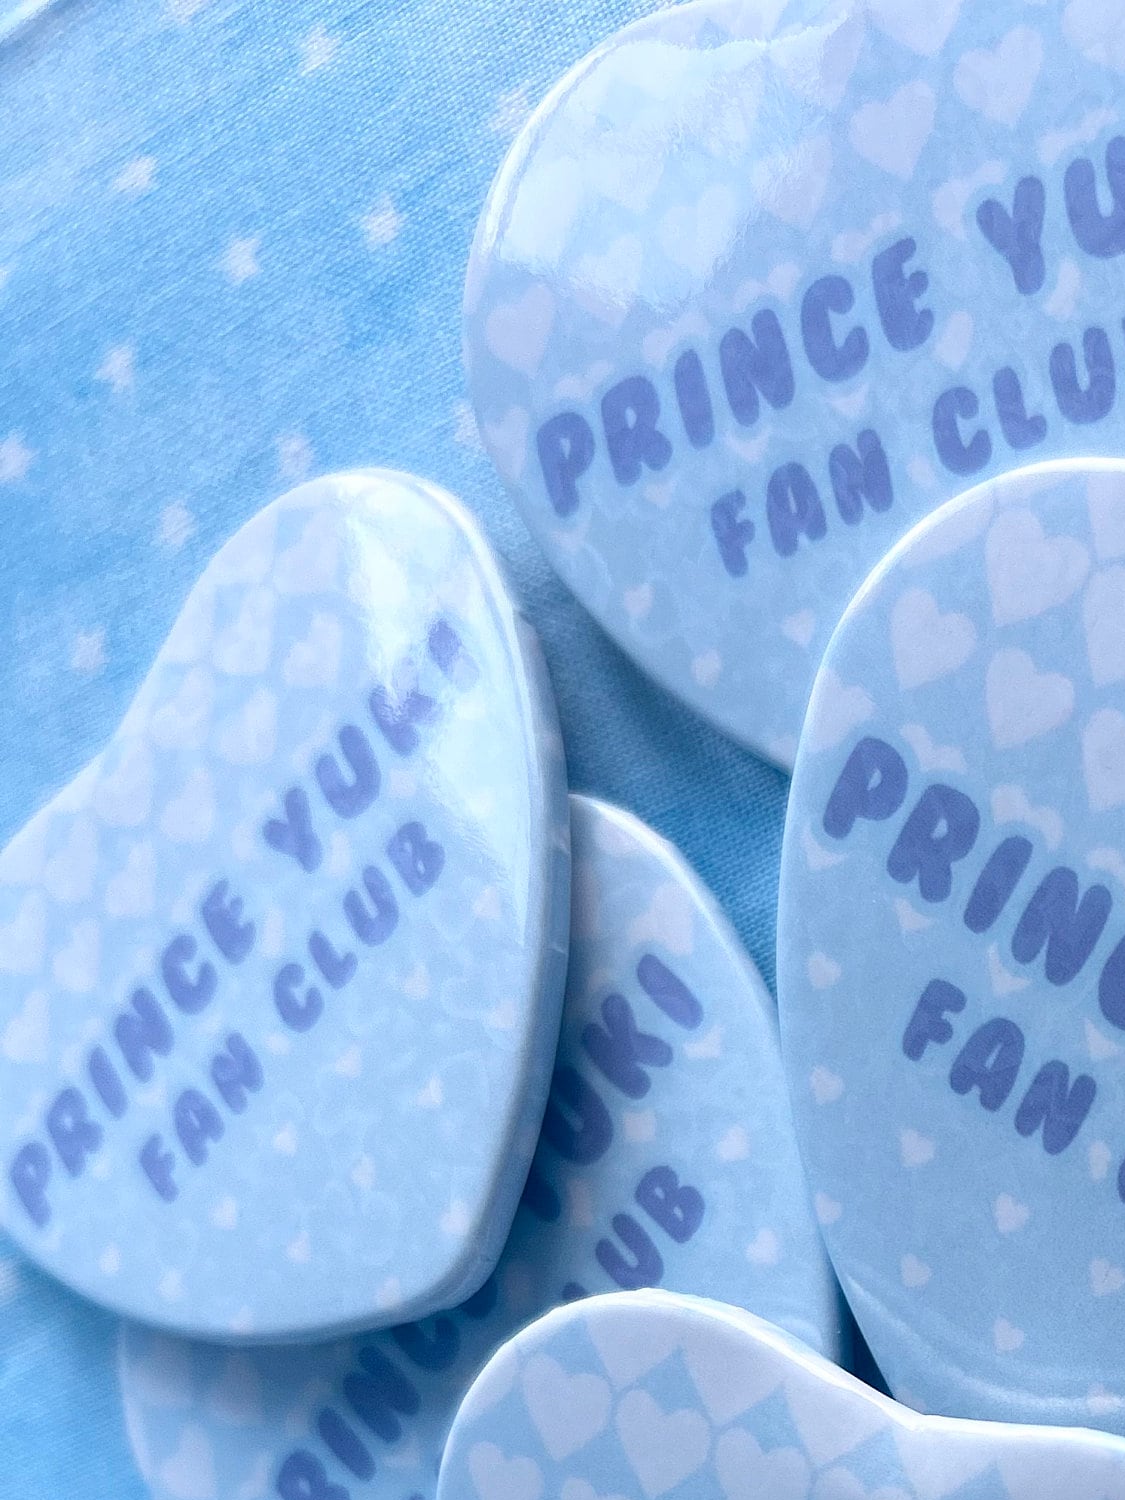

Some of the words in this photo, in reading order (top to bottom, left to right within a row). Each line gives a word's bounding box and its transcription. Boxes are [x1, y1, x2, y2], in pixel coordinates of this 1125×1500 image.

[535, 236, 936, 518] PRINCE
[710, 428, 894, 577] FAN
[11, 879, 256, 1230] PRINCE
[139, 1031, 264, 1202] FAN
[272, 821, 445, 1033] CLUB
[521, 954, 704, 1222] UKI
[902, 979, 1097, 1155] FAN
[562, 1165, 705, 1300] UB
